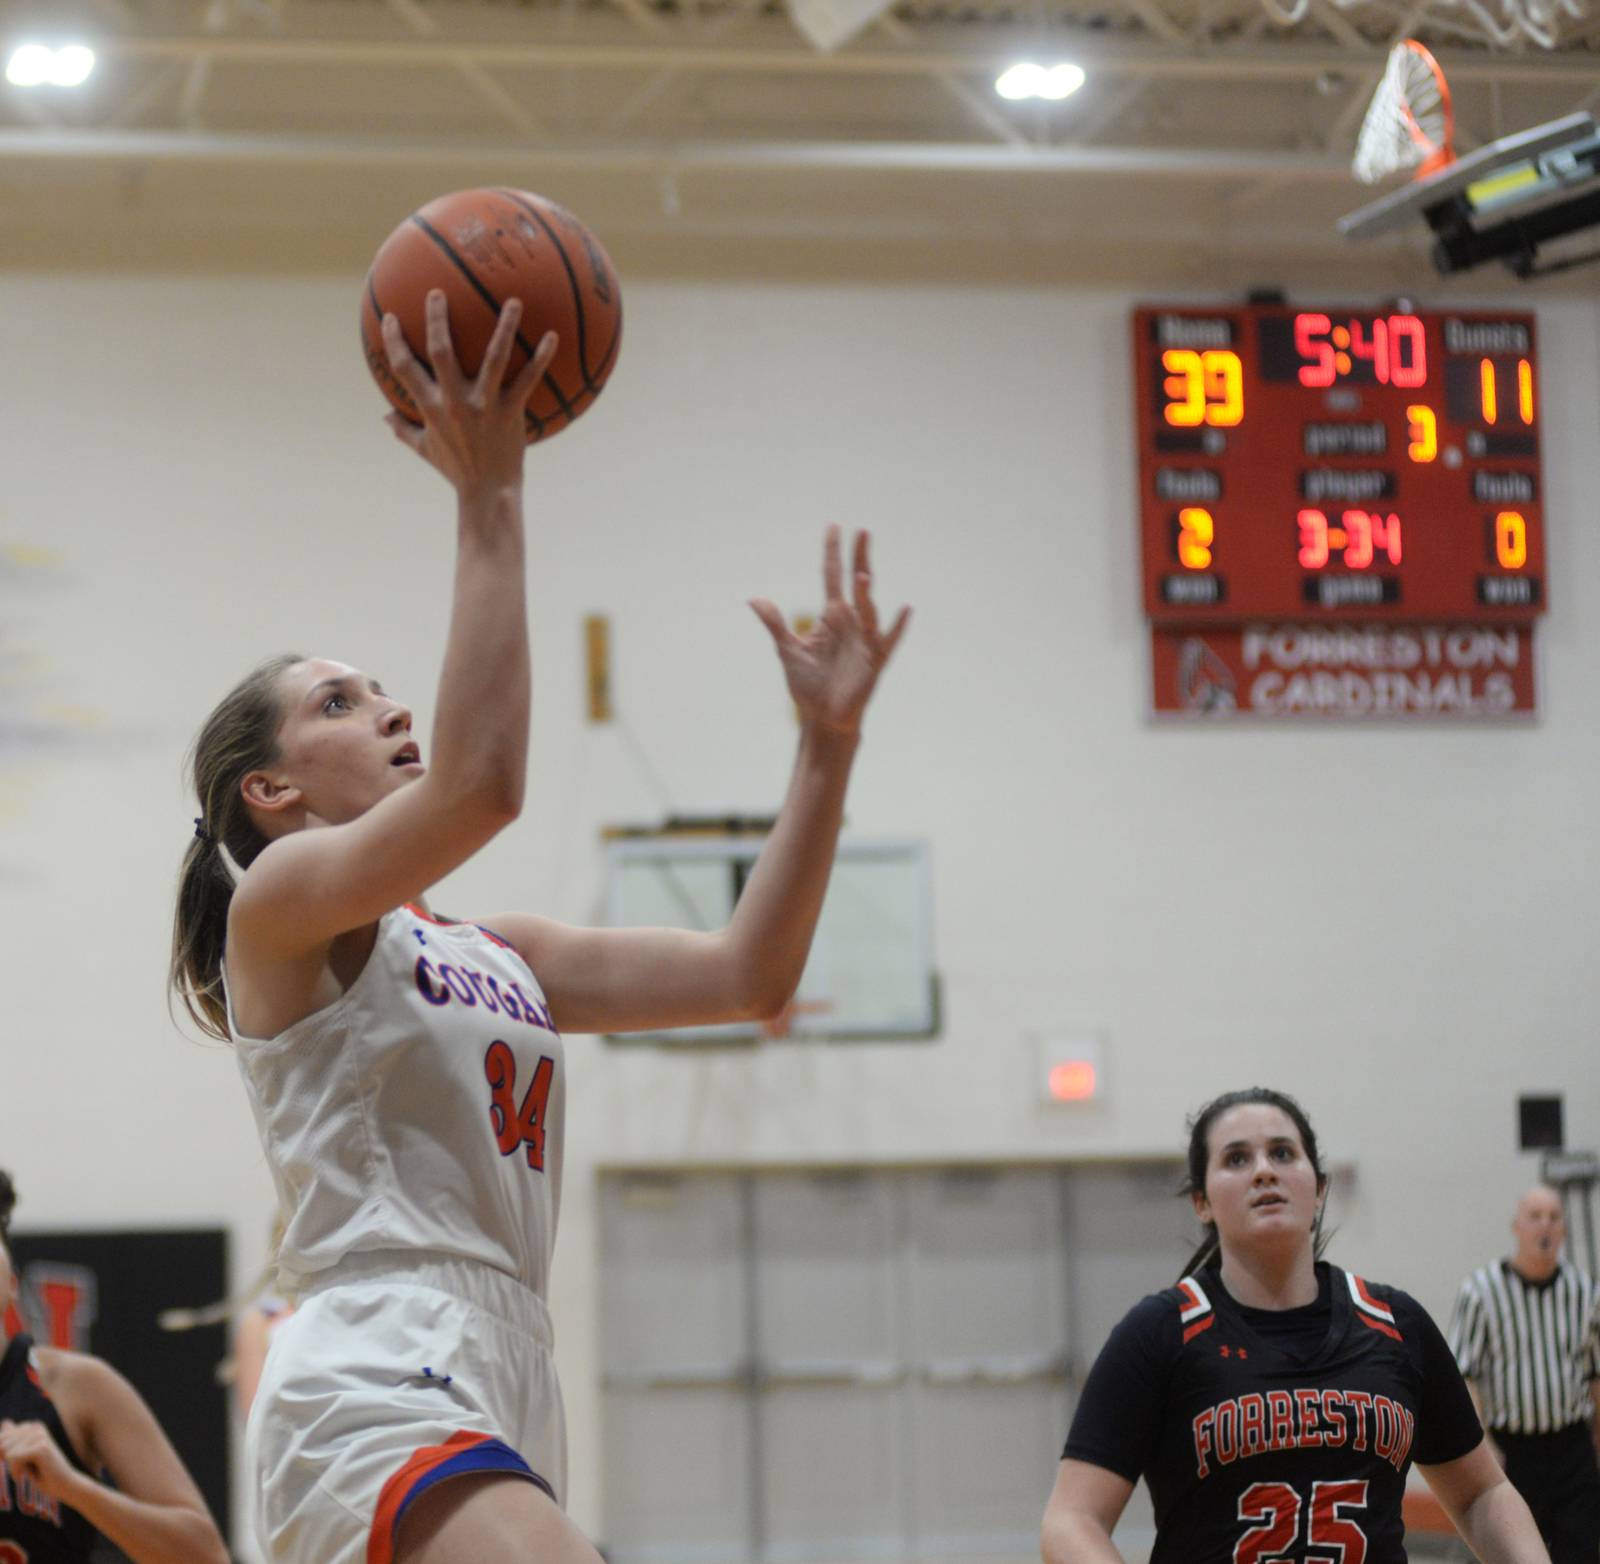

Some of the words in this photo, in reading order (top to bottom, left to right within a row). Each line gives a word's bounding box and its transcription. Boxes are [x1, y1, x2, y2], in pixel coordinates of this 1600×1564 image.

[1295, 314, 1427, 387] 5:40
[1162, 350, 1244, 426] 39
[1481, 358, 1533, 424] 11
[1407, 405, 1437, 462] 3
[1178, 508, 1213, 568] 2
[1297, 510, 1401, 568] 3-34
[1496, 511, 1527, 568] 0
[1243, 628, 1519, 668] FORRESTON
[1250, 672, 1514, 713] CARDINALS
[484, 1040, 554, 1172] 34
[1193, 1389, 1414, 1479] FORRESTON
[1233, 1480, 1369, 1564] 25
